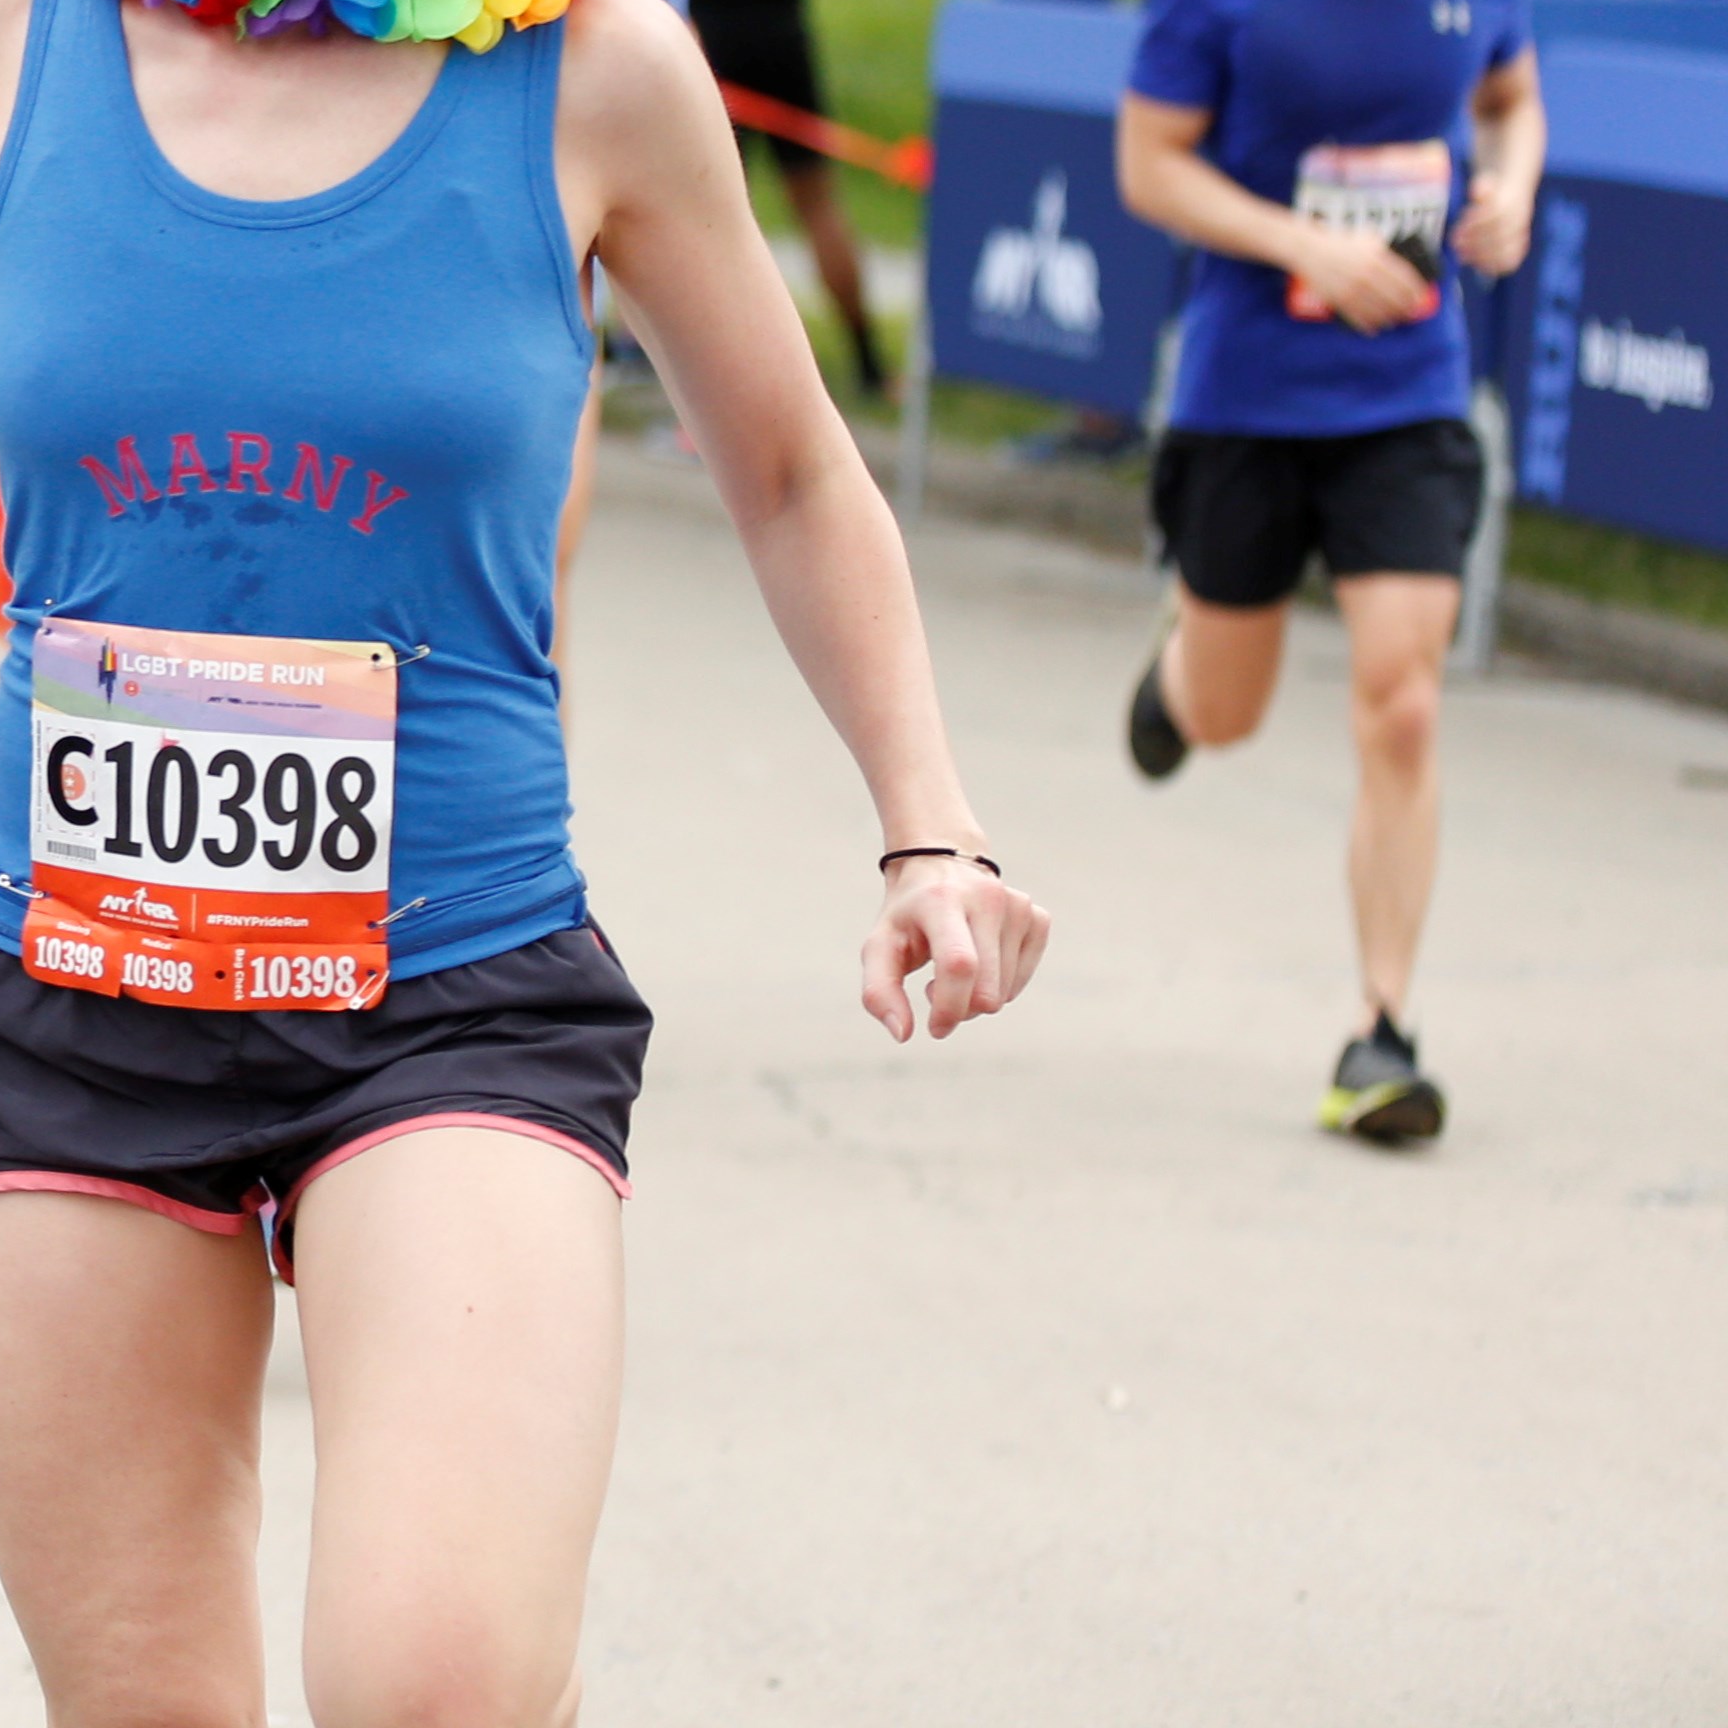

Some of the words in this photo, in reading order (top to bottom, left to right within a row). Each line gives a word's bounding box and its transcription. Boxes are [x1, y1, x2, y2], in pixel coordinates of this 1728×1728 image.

[78, 431, 410, 535] MARNY
[122, 653, 183, 677] LGBT
[188, 659, 265, 683] PRIDE
[271, 664, 325, 686] RUN
[206, 913, 310, 928] #FRNYPrideRun
[34, 936, 105, 978] 10398
[121, 953, 193, 993] 10398
[233, 948, 245, 969] Bag
[234, 971, 245, 1001] Check
[250, 955, 357, 999] 10398
